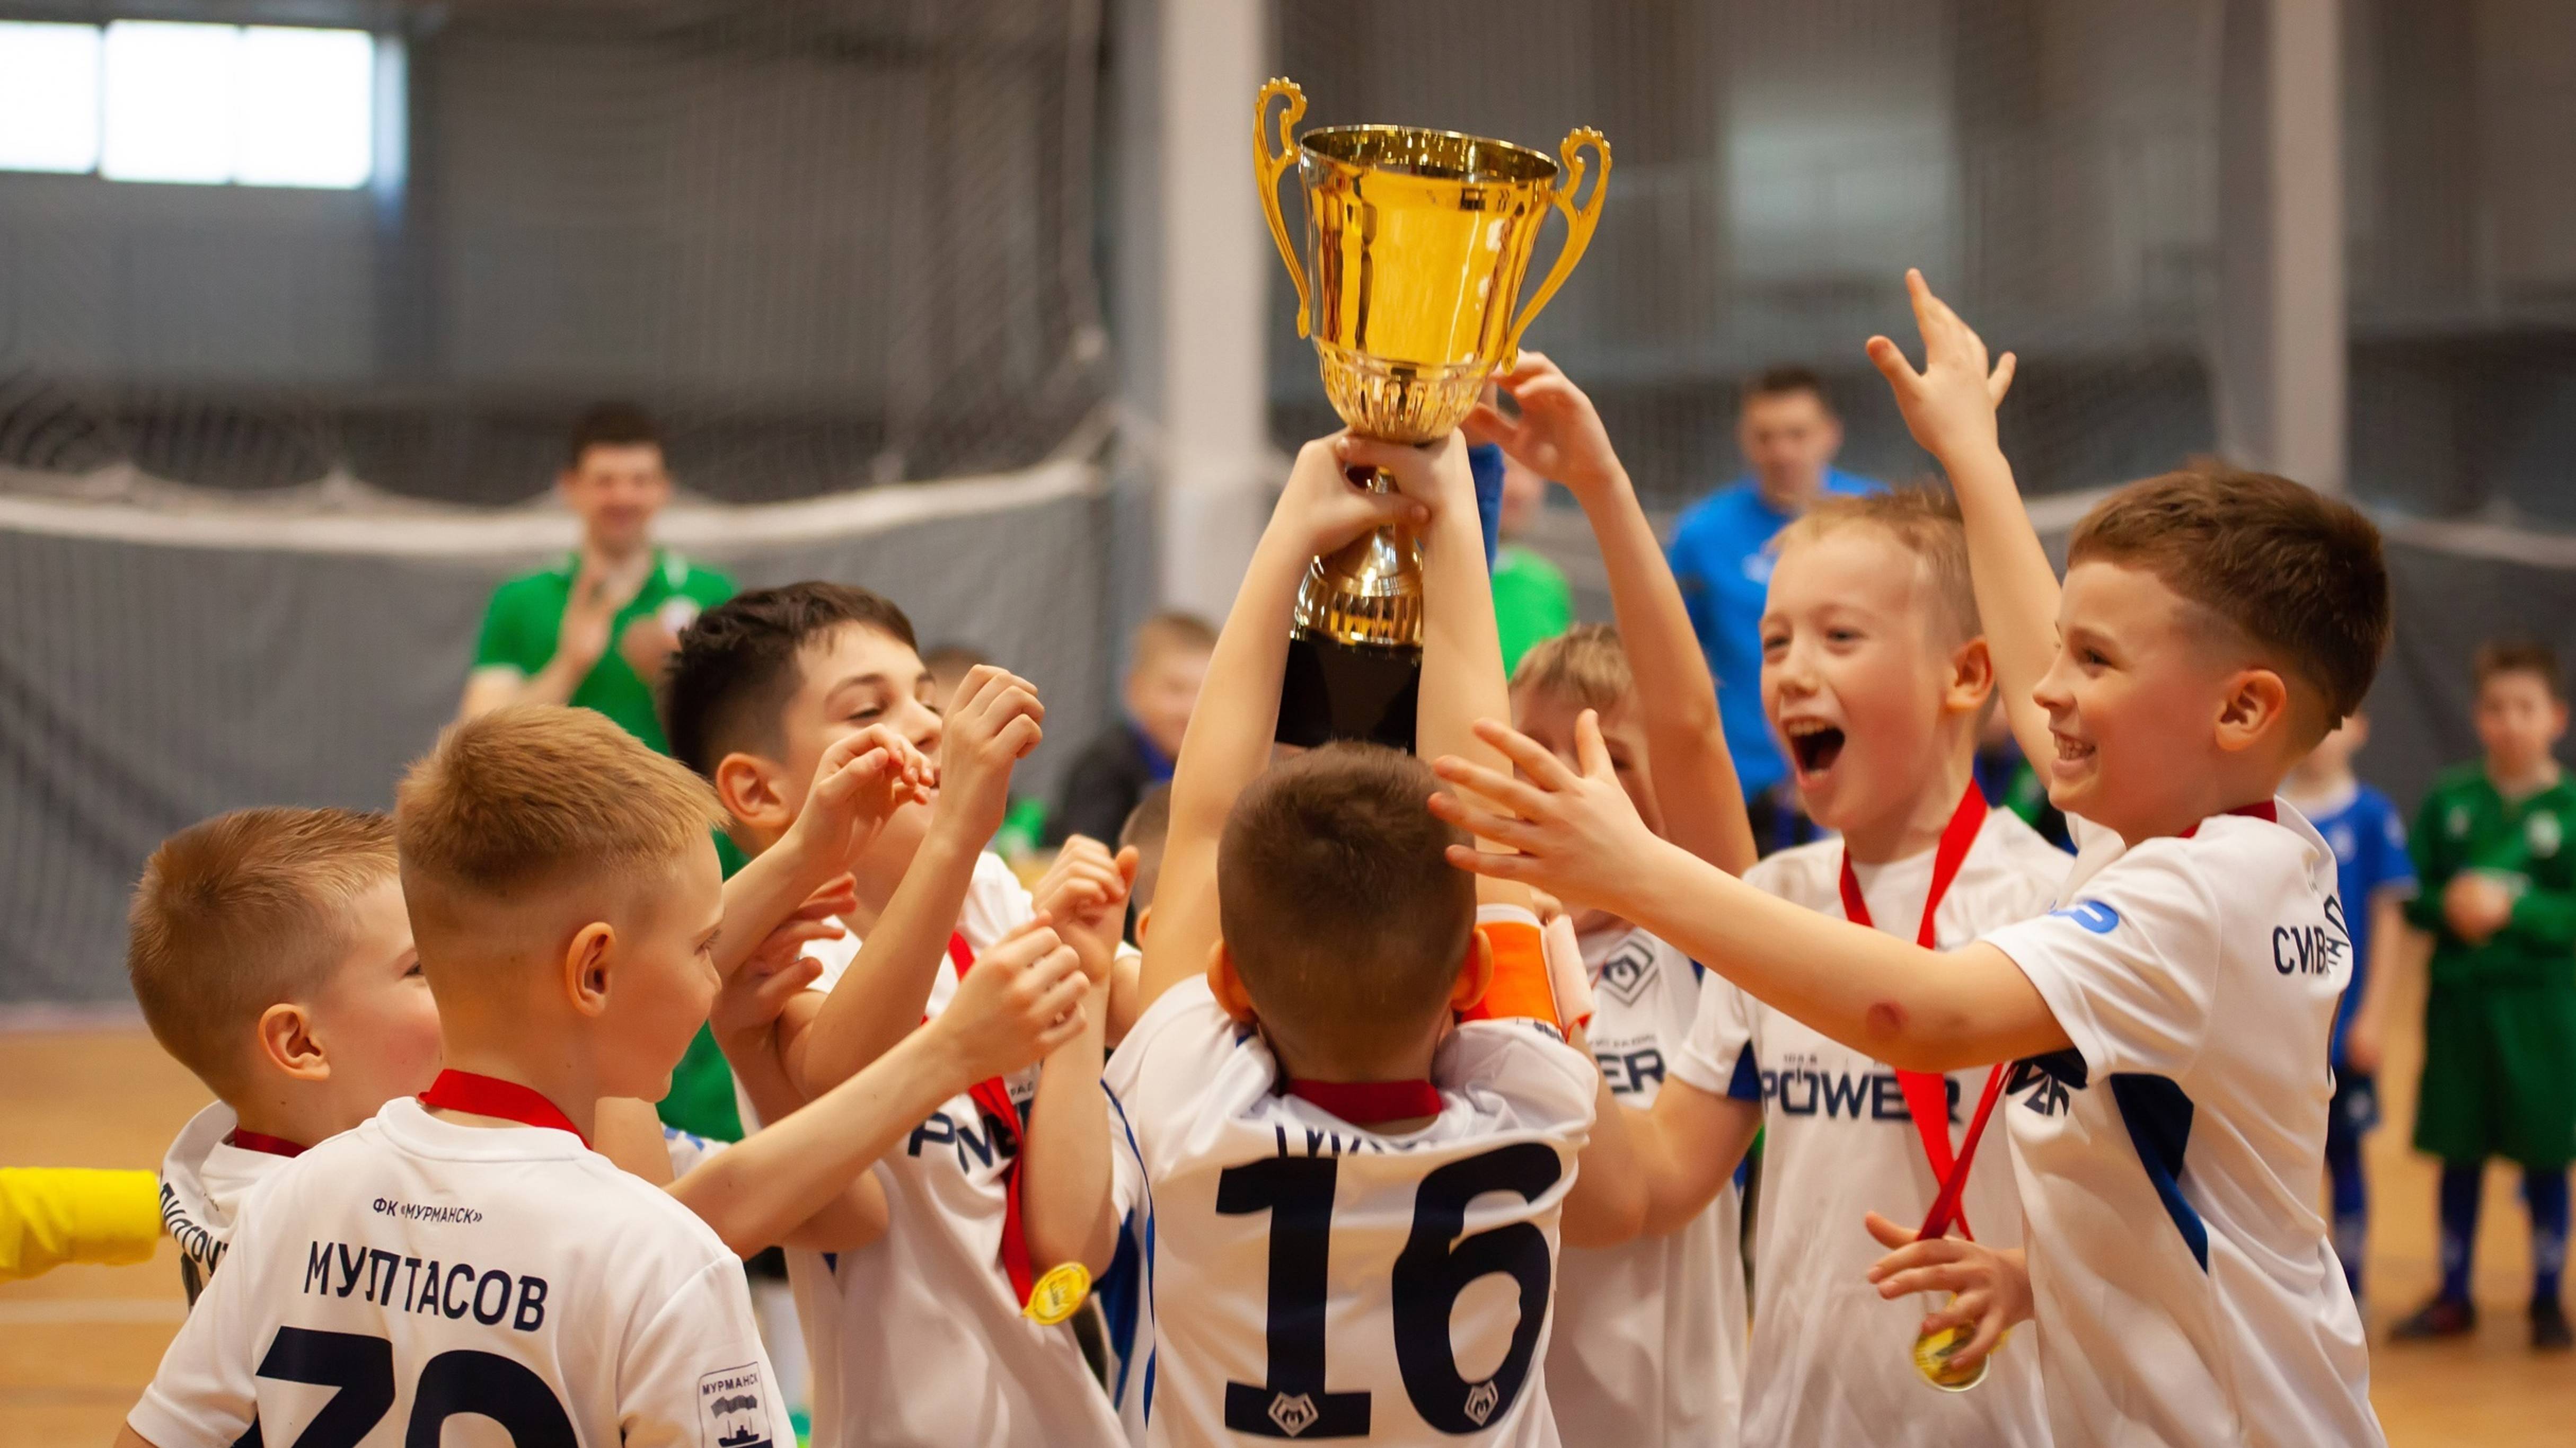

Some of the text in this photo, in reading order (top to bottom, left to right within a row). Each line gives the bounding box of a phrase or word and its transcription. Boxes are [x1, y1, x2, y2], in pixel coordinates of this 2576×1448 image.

[373, 1198, 398, 1217] ФК
[304, 1241, 548, 1332] МУЛТАСОВ
[1215, 1142, 1562, 1437] 16
[702, 1373, 758, 1395] МУРМАНСК
